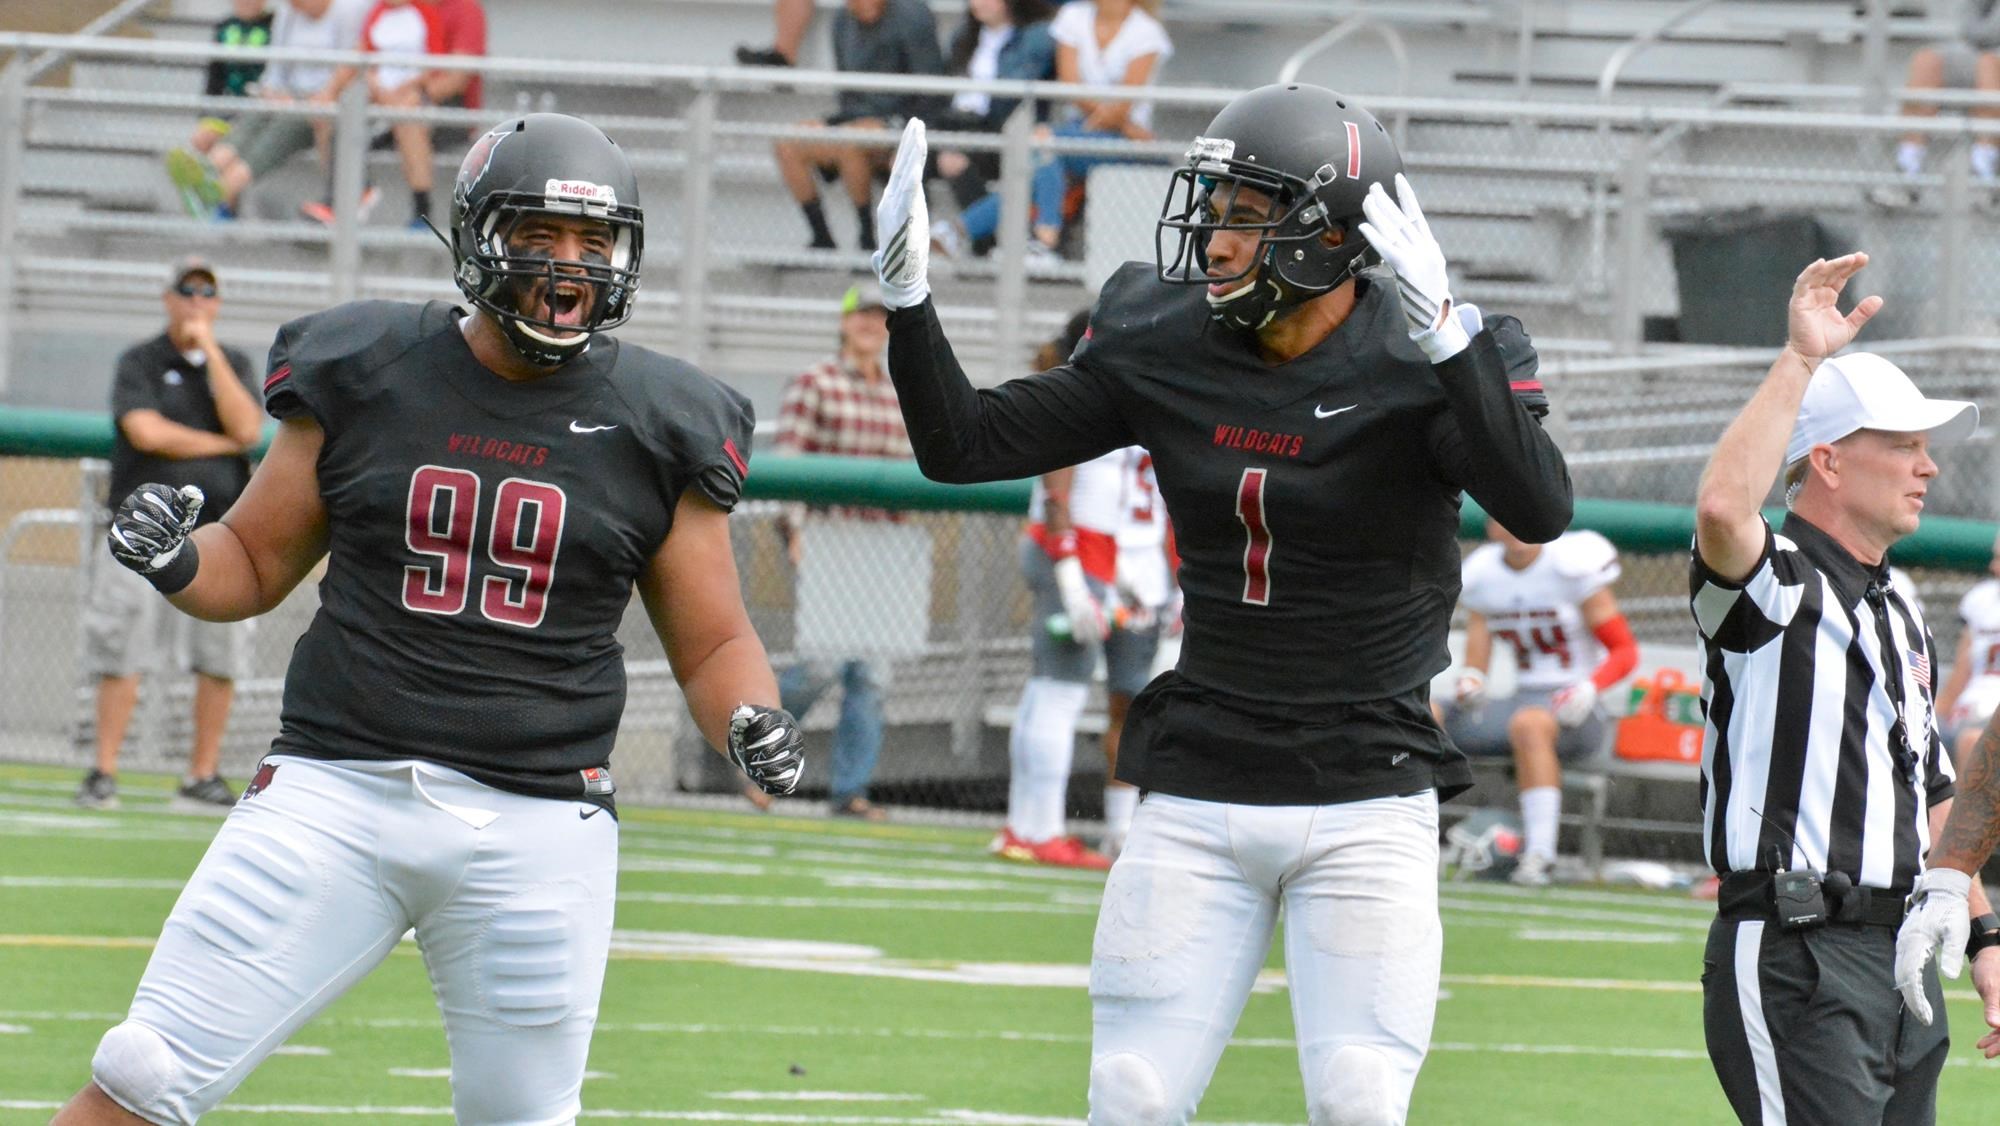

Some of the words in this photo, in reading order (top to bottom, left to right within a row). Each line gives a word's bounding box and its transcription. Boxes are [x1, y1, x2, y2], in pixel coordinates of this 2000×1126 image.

[1343, 121, 1361, 180] 1
[447, 432, 550, 467] WILDCATS
[1213, 424, 1304, 457] WILDCATS
[401, 464, 567, 629] 99
[1235, 467, 1273, 606] 1
